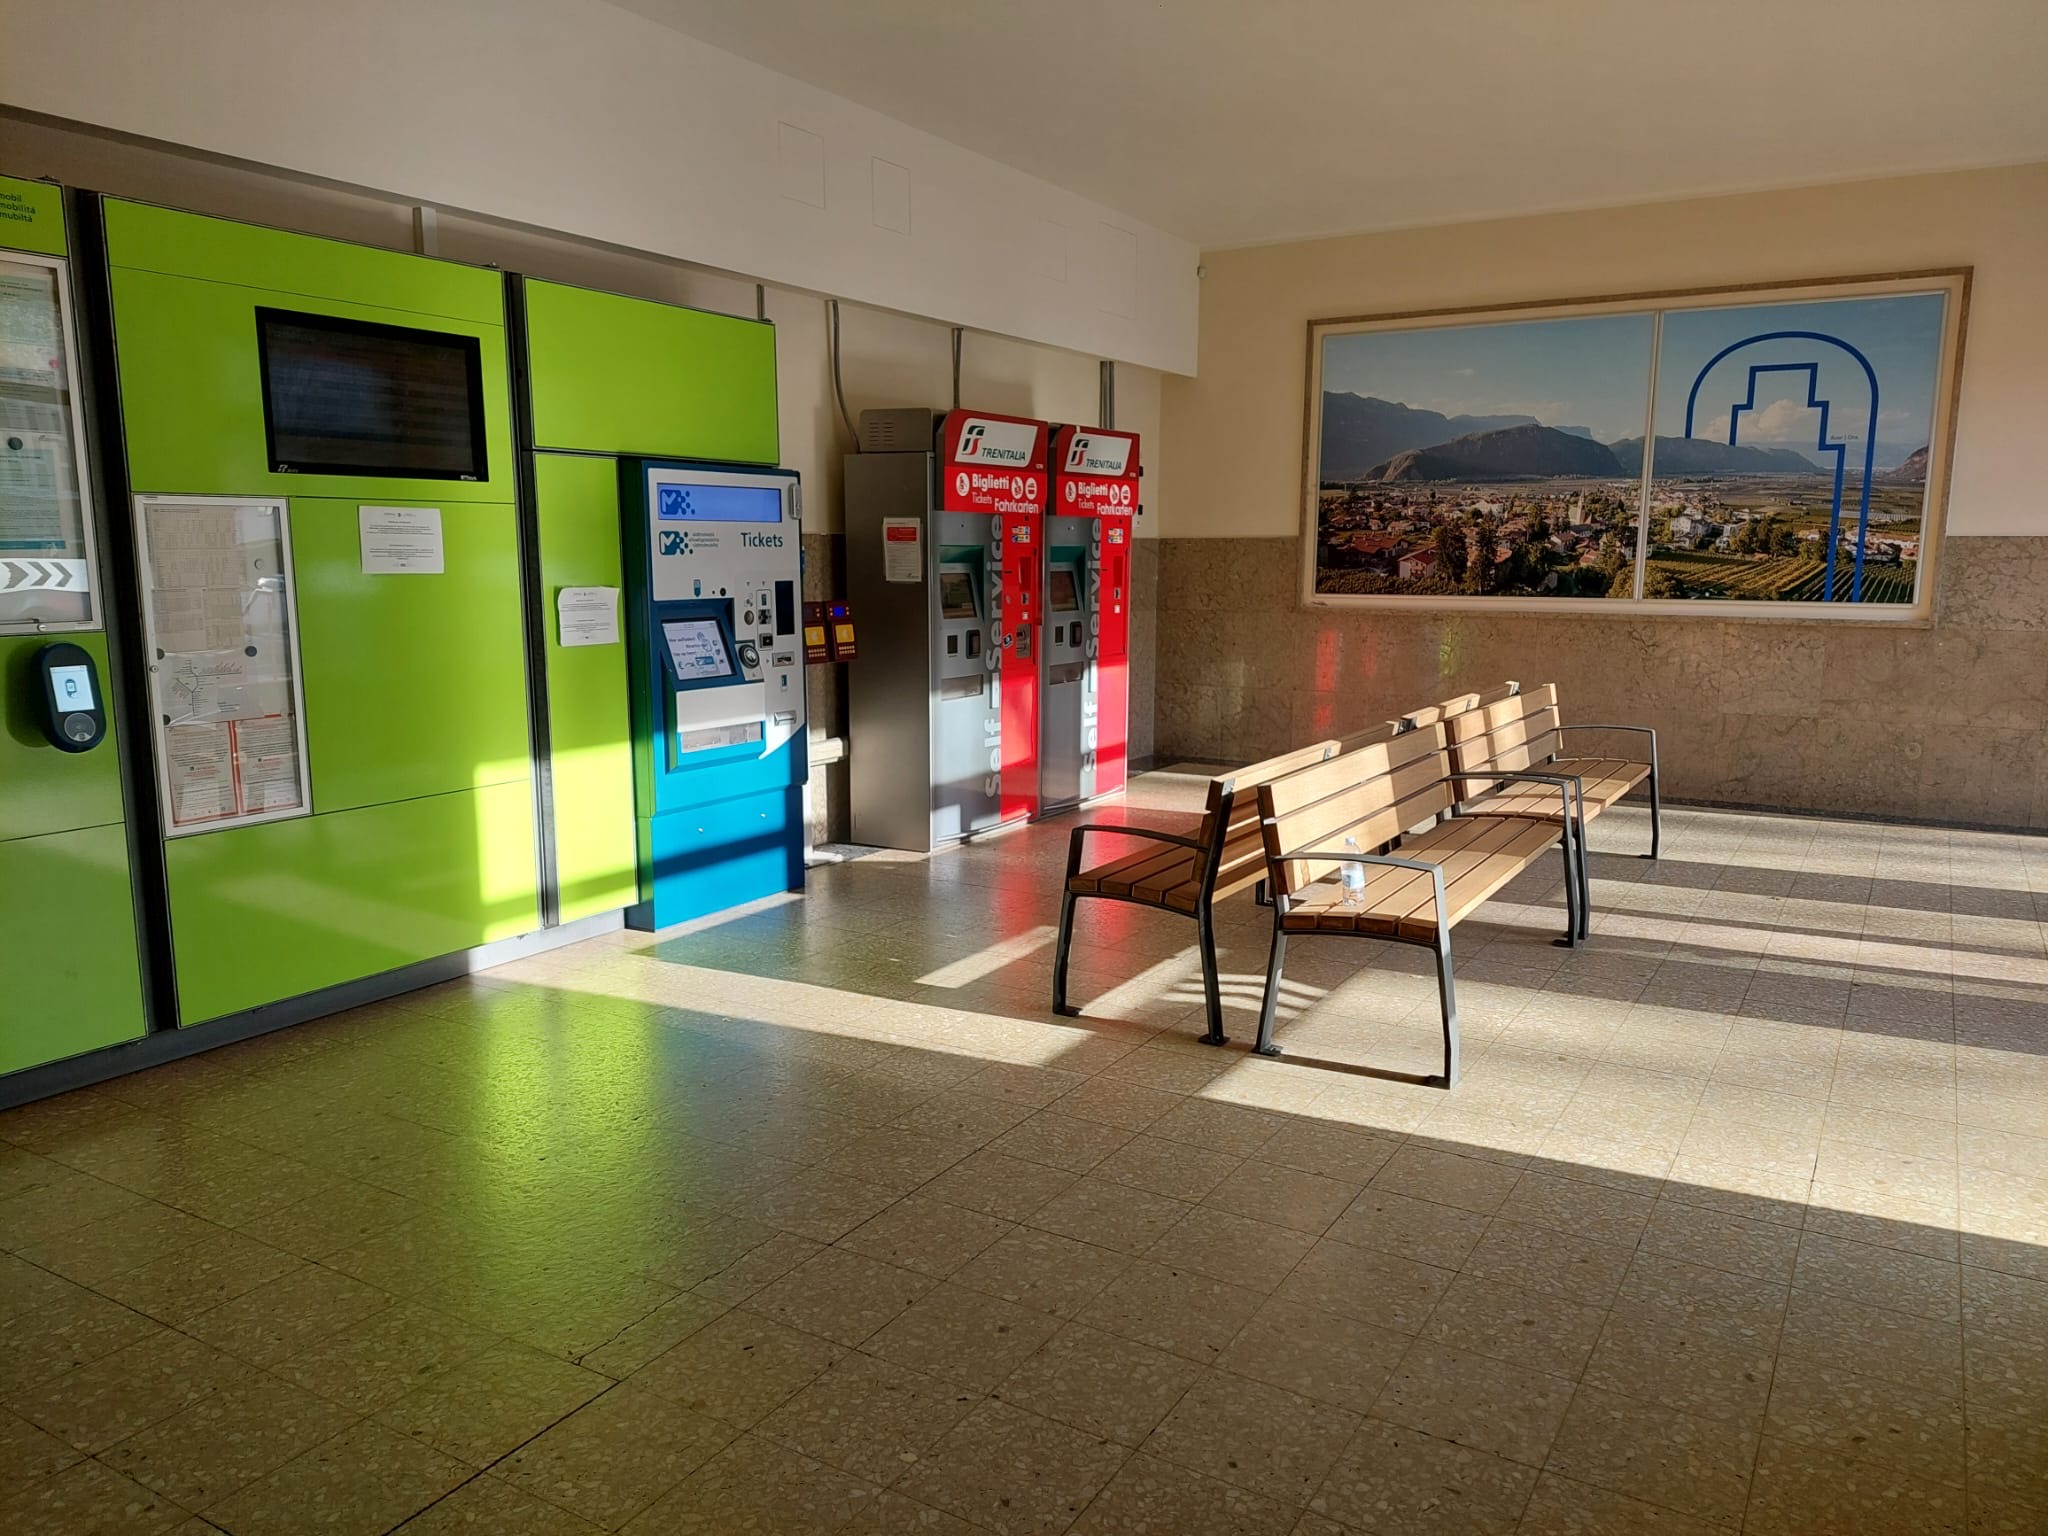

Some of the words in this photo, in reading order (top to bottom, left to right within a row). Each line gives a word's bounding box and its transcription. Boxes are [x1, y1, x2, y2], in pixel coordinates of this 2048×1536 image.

[982, 447, 1026, 461] TRENITALIA
[1086, 458, 1122, 471] TRENITALIA
[972, 473, 1010, 492] Biglietti
[1078, 481, 1109, 498] Biglietti
[972, 492, 993, 505] Tickets
[1078, 498, 1095, 509] Tickets
[994, 499, 1039, 514] Fahrkarten
[1097, 503, 1133, 516] Fahrkarten
[740, 532, 784, 548] Tickets
[985, 515, 1003, 671] Service
[1086, 519, 1101, 660] Service
